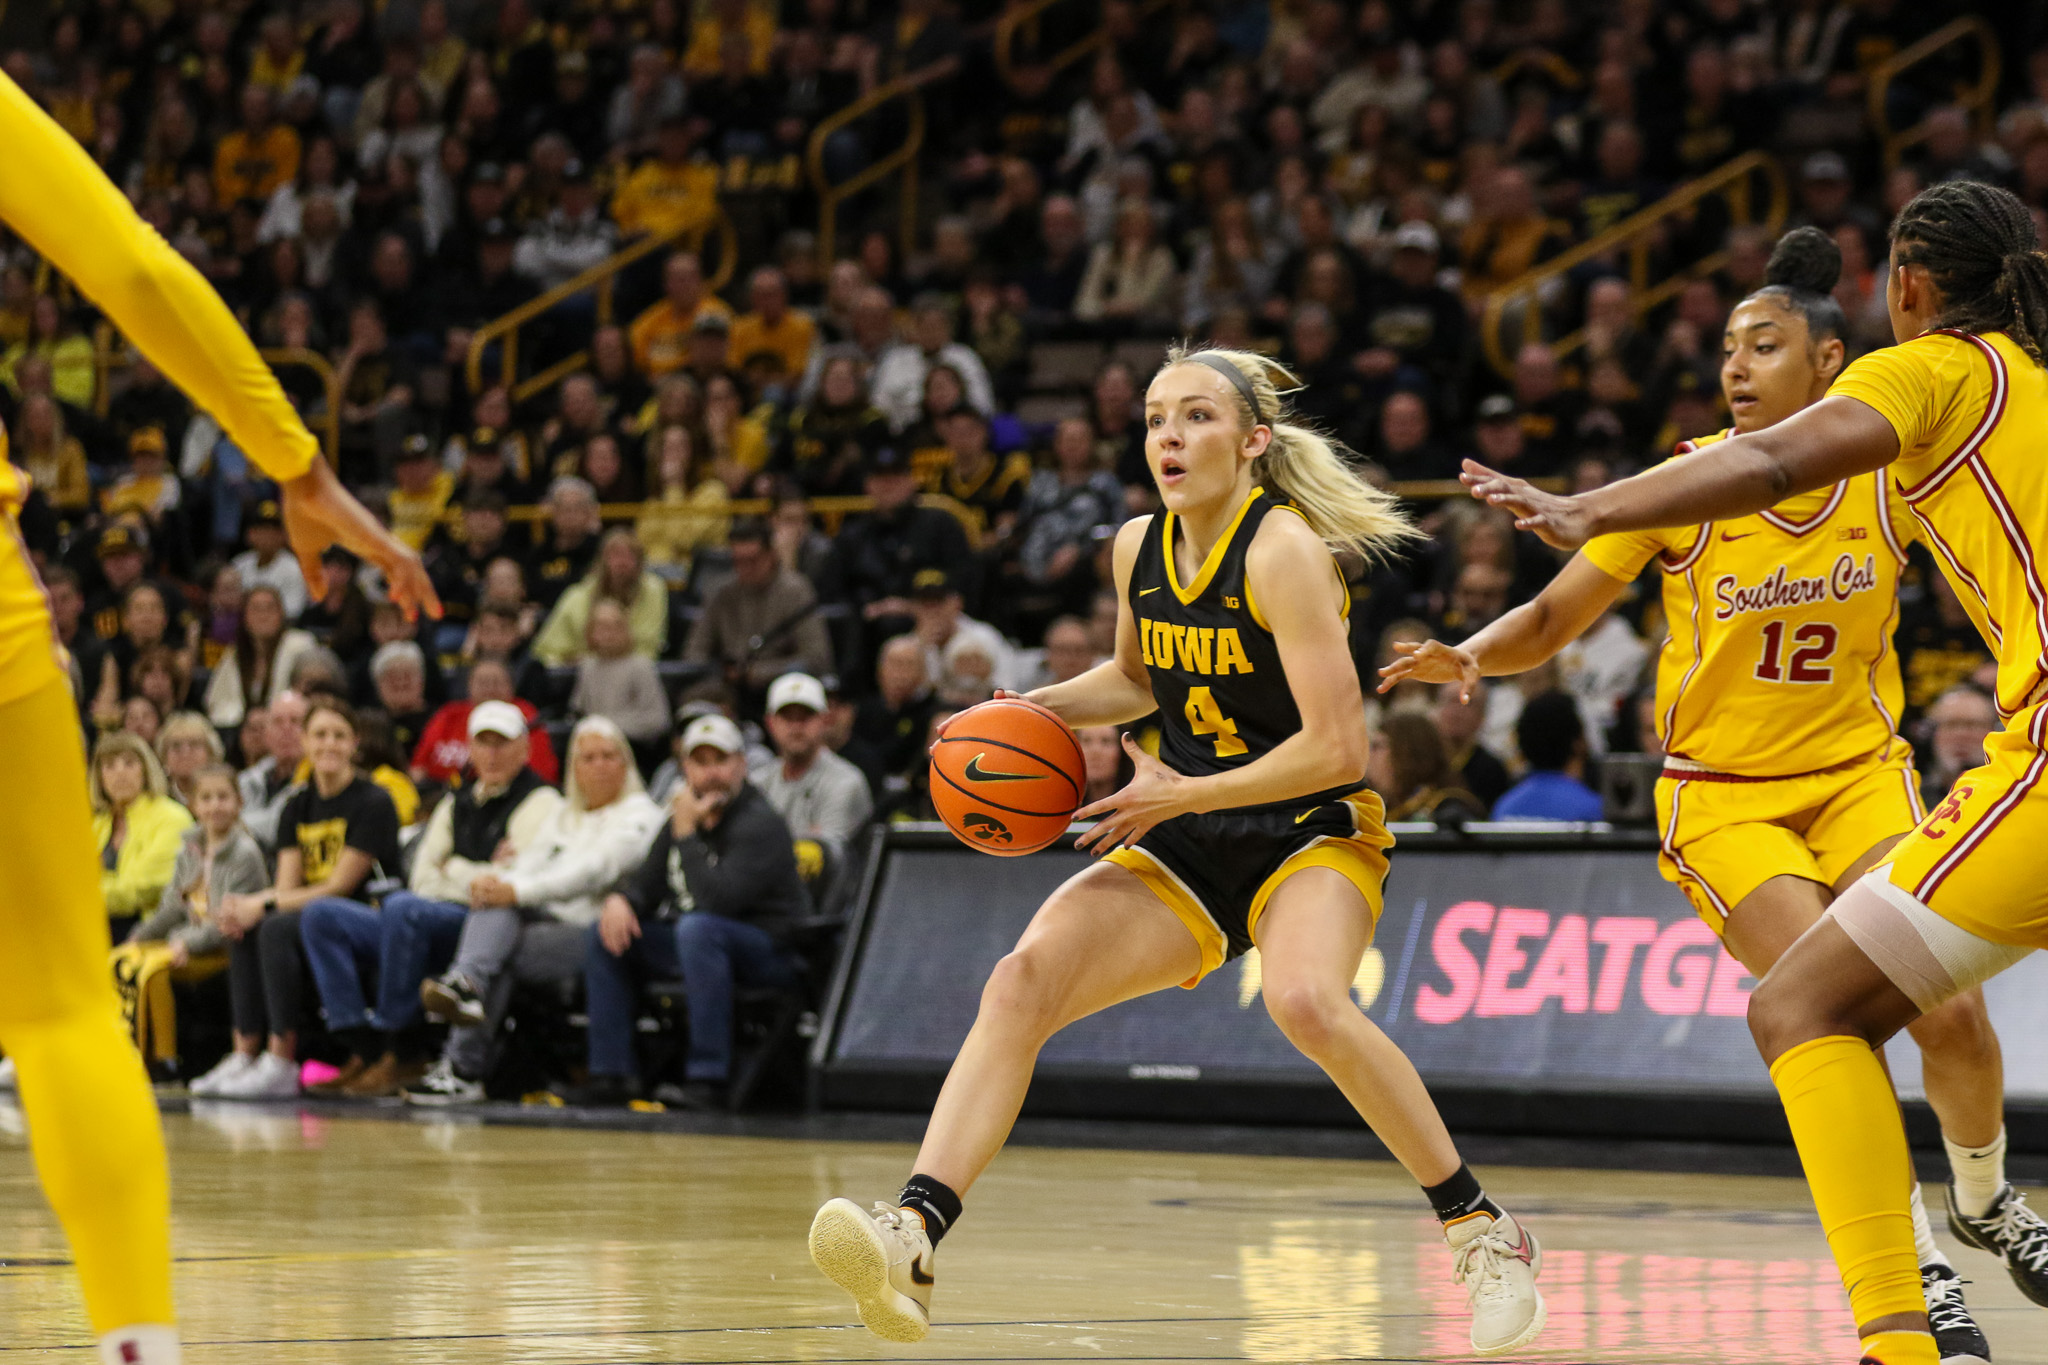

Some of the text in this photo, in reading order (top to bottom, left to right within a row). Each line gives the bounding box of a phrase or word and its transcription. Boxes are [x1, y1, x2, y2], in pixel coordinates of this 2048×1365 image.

[1715, 552, 1877, 621] Southern Cal
[1140, 617, 1255, 675] IOWA
[1753, 619, 1839, 685] 12
[1184, 686, 1249, 757] 4
